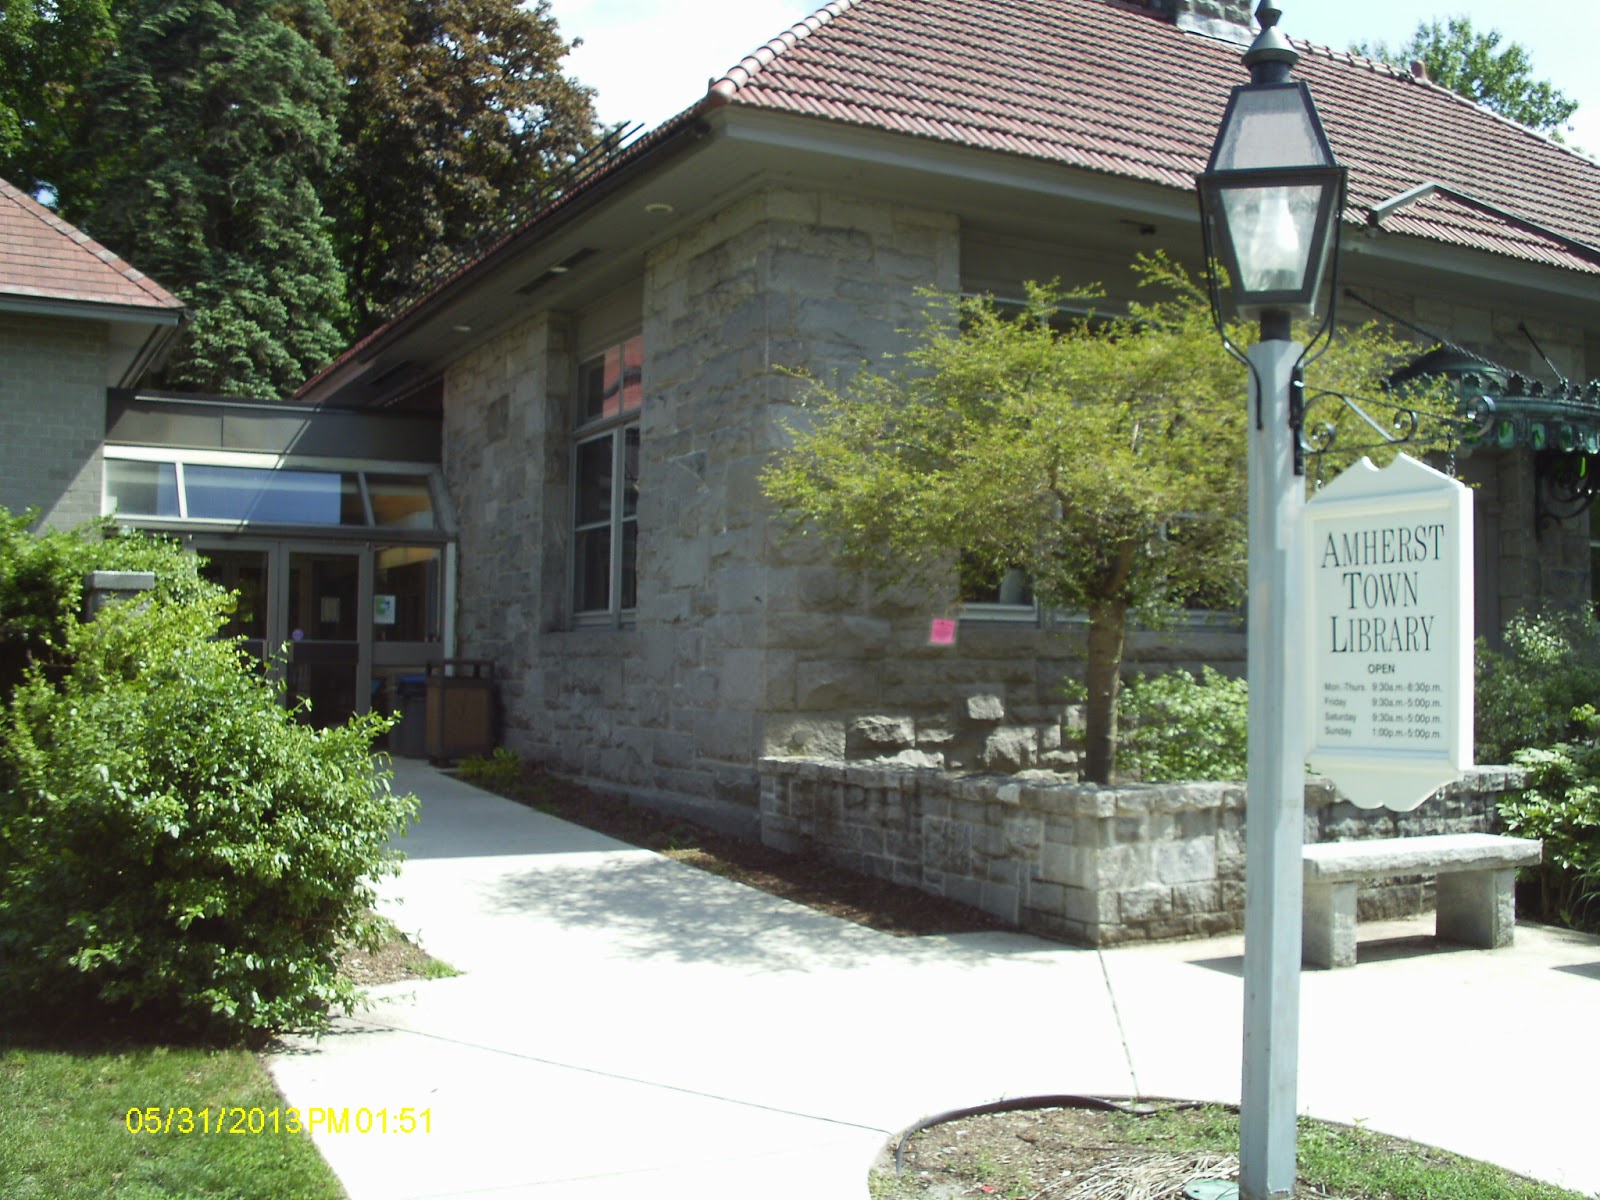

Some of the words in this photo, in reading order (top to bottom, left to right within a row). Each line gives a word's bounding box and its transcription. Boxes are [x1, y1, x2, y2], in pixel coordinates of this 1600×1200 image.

[1321, 524, 1444, 568] AMHERST
[1343, 571, 1418, 610] TOWN
[1330, 615, 1434, 653] LIBRARY
[1368, 663, 1395, 674] OPEN
[1324, 697, 1346, 708] Friday
[1325, 712, 1357, 723] Saturday
[1325, 726, 1352, 737] Sunday
